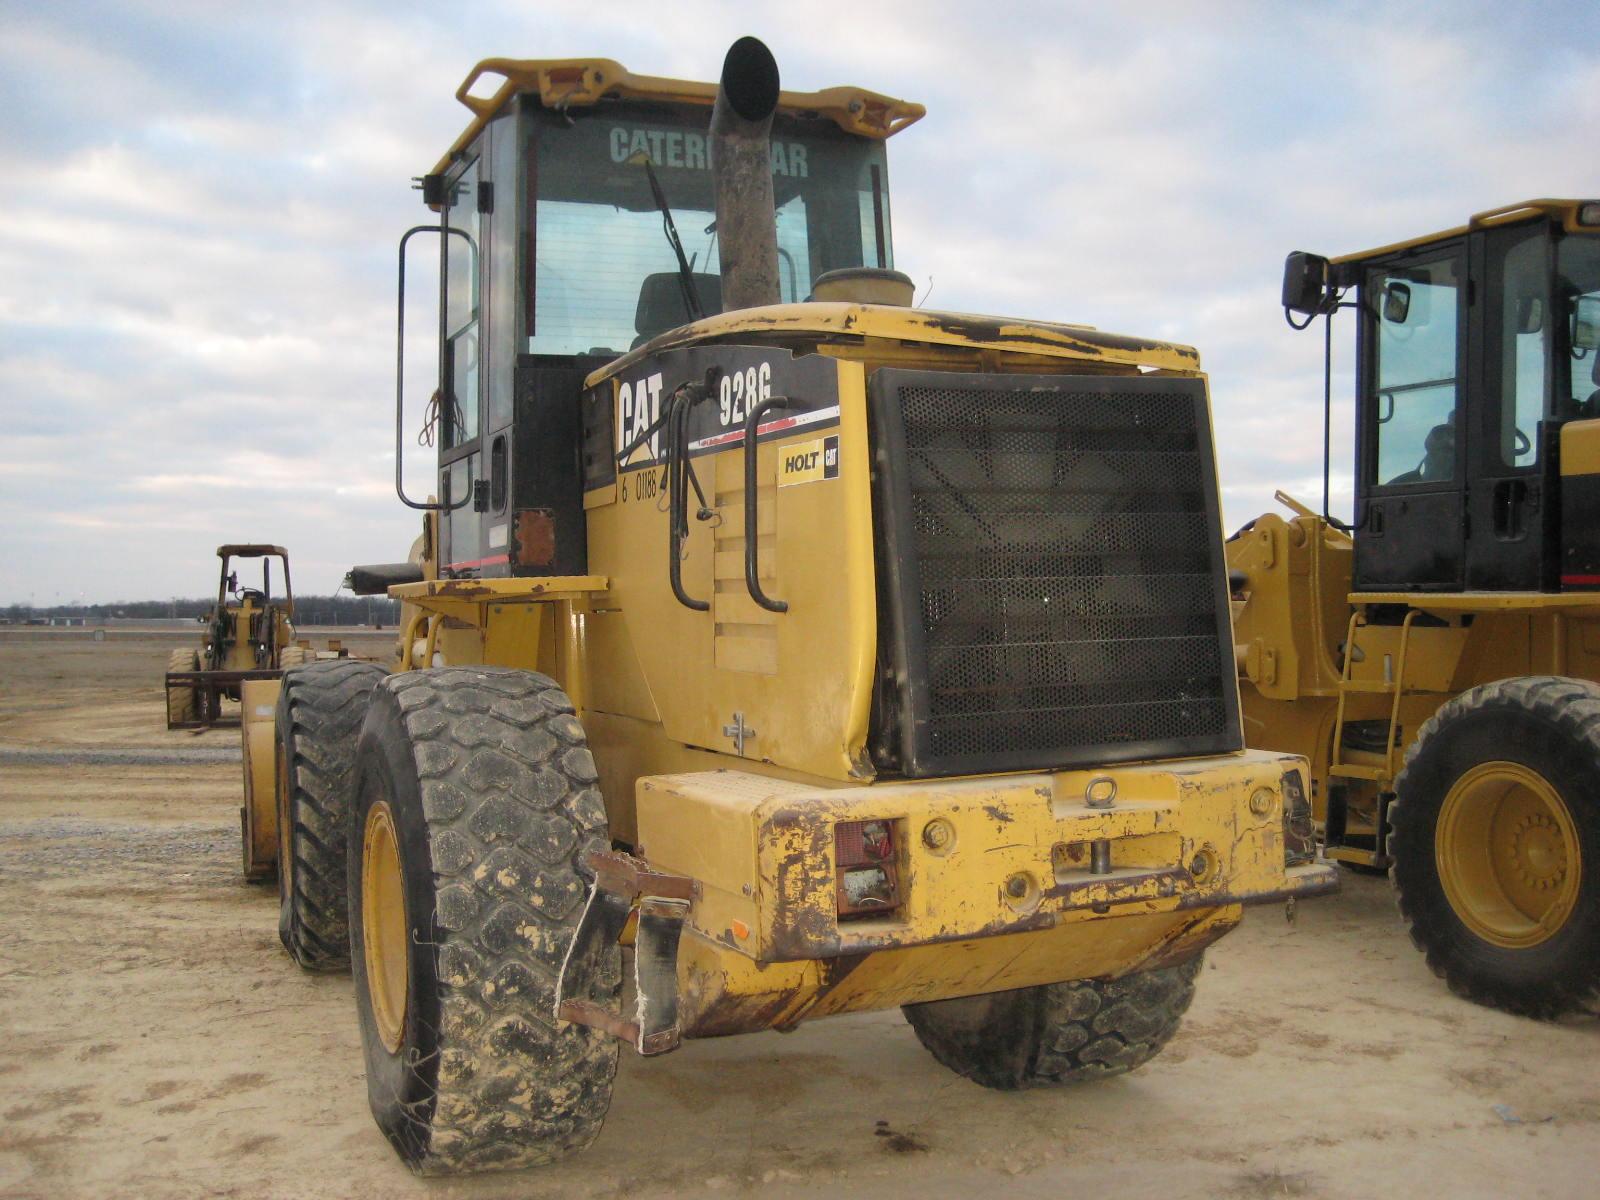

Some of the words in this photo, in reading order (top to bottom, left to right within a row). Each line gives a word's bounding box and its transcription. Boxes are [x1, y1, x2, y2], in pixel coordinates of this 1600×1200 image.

[609, 127, 809, 178] CATERAR
[618, 372, 663, 467] CAT
[720, 361, 771, 427] 928G
[784, 451, 820, 474] HOLT
[825, 448, 838, 467] CAT
[621, 476, 628, 503] 6
